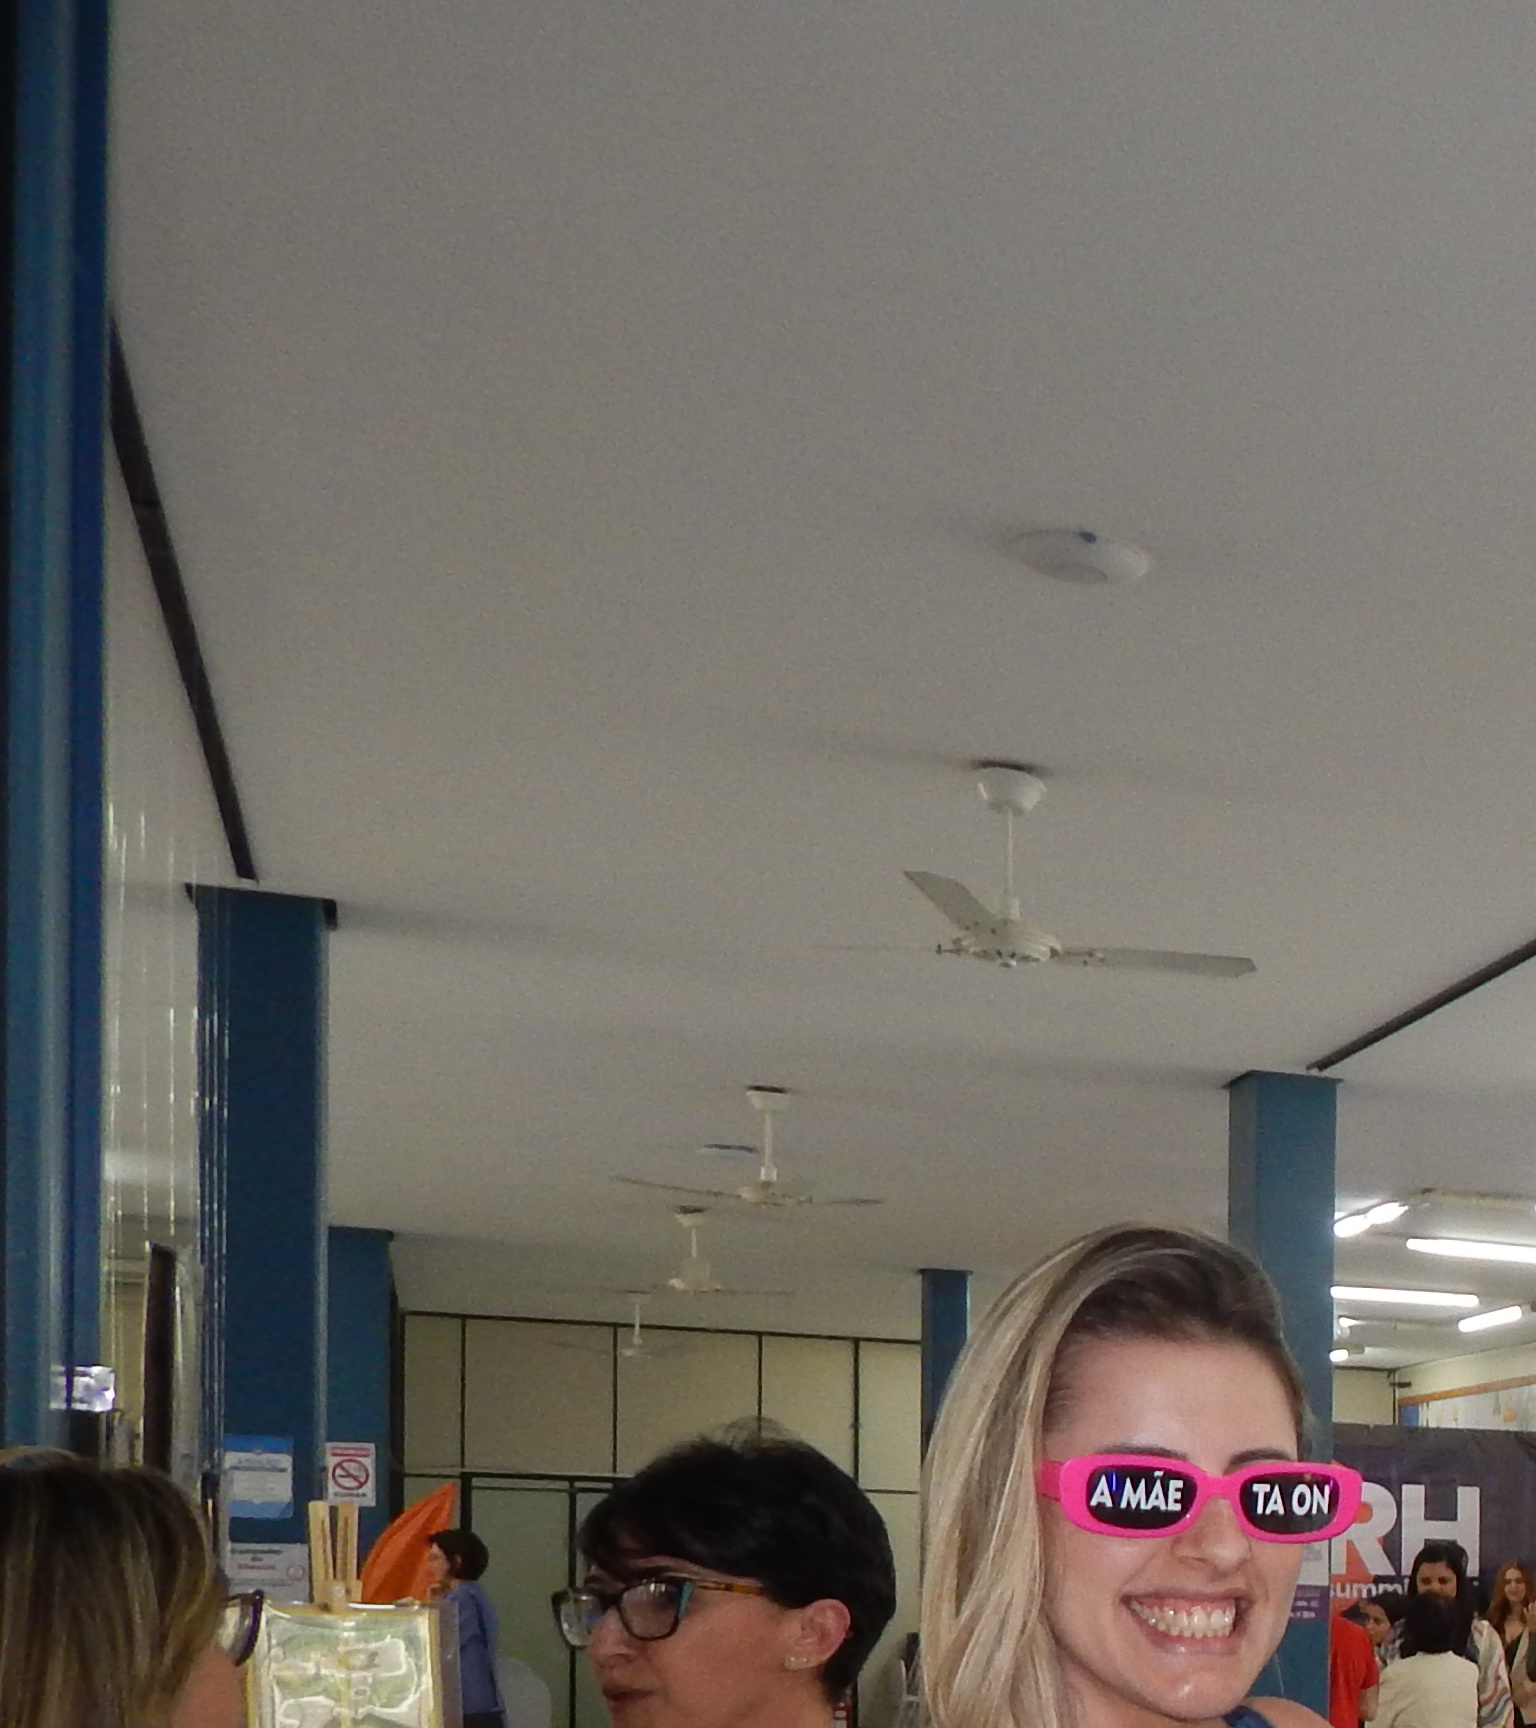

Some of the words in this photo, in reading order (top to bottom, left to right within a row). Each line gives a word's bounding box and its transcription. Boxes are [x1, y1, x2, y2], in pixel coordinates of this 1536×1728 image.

[1089, 1474, 1115, 1508] A
[1120, 1469, 1184, 1512] MÃE
[1252, 1484, 1284, 1516] TA
[1292, 1485, 1330, 1516] ON
[1331, 1481, 1480, 1577] RH
